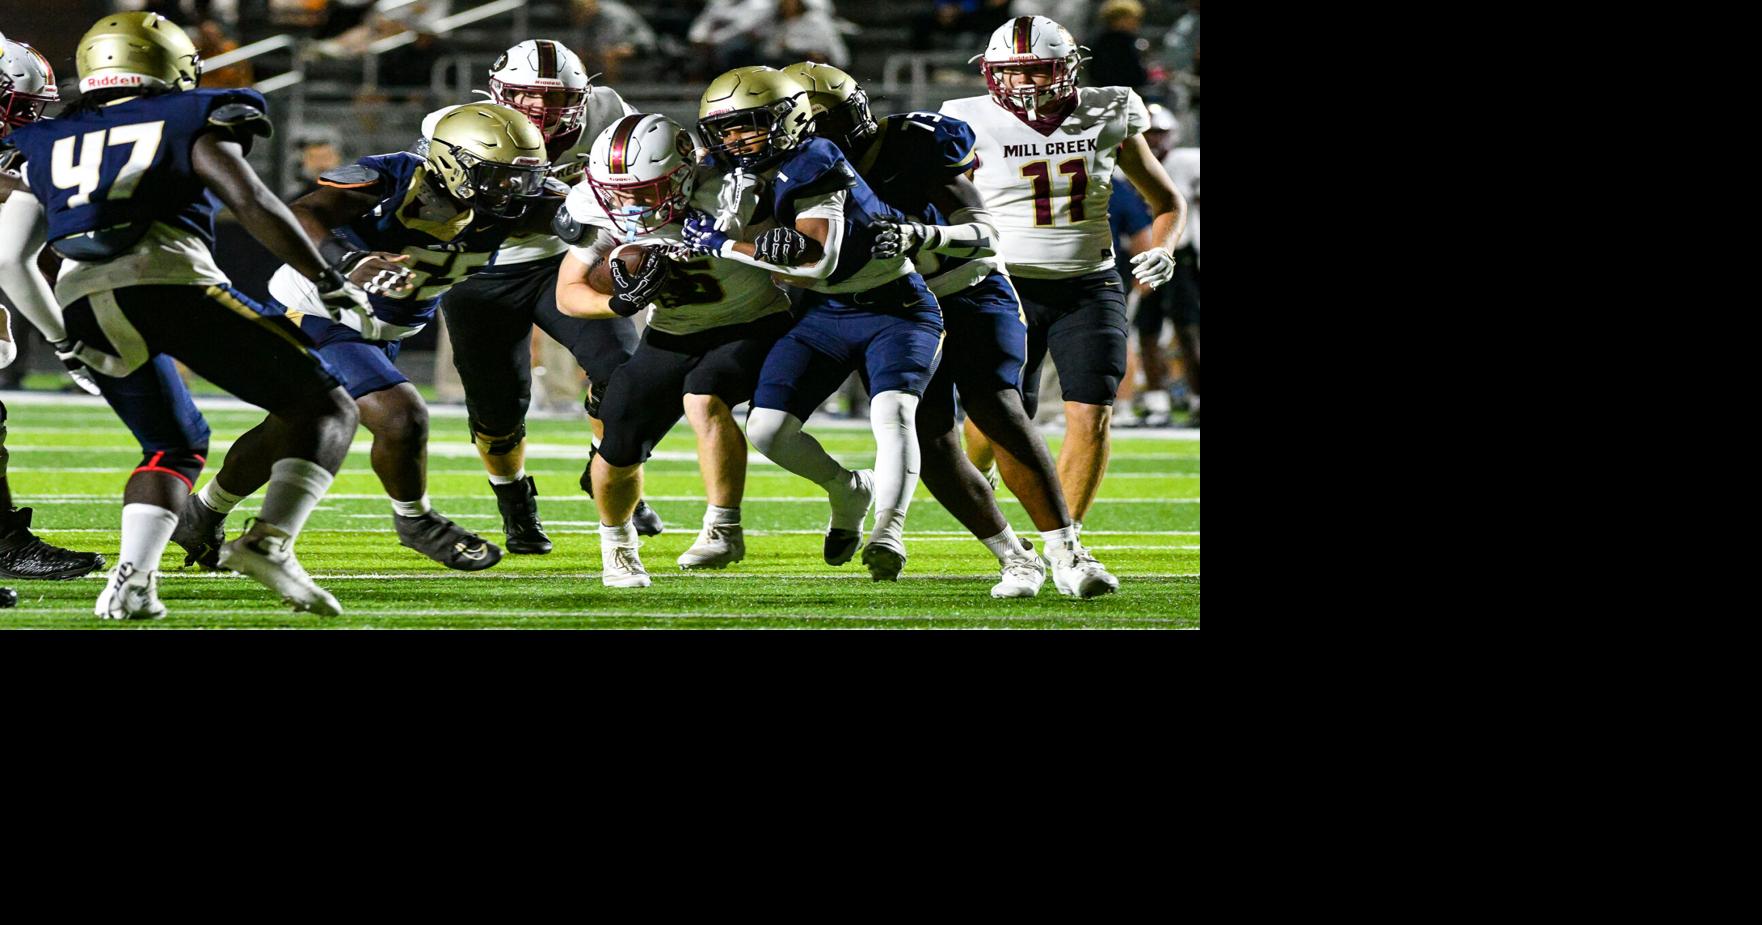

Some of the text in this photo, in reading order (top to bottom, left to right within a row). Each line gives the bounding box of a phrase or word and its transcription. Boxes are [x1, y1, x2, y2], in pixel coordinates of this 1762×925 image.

[88, 76, 141, 88] Riddell
[51, 120, 165, 208] 47
[1003, 138, 1097, 158] MILL CREEK
[1018, 156, 1088, 228] 11
